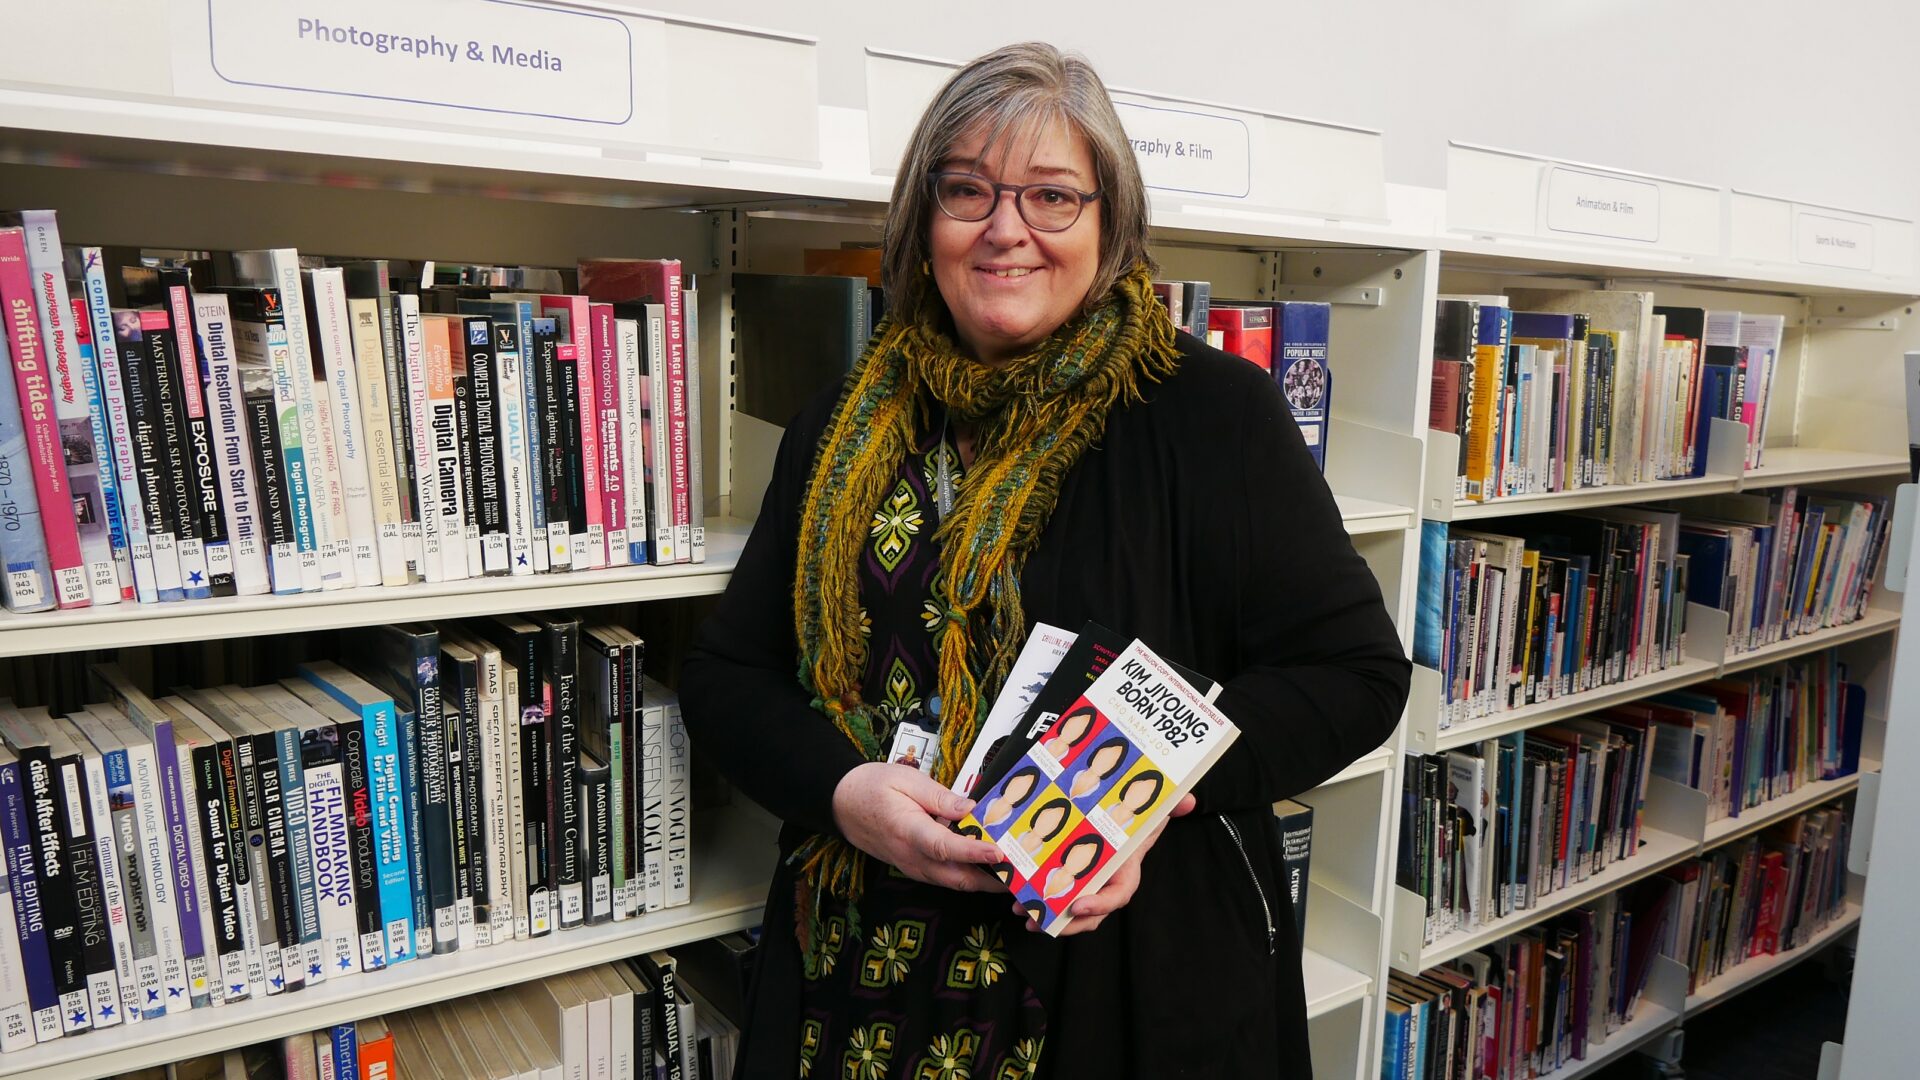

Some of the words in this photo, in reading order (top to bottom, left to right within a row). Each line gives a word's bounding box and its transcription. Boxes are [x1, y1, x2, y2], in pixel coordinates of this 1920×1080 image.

[298, 18, 458, 63] Photography
[466, 41, 484, 62] &
[492, 44, 562, 72] Media
[1175, 140, 1185, 157] &
[1189, 143, 1213, 161] Film
[1576, 195, 1611, 213] Animation
[1613, 201, 1618, 213] &
[1620, 202, 1634, 215] Film
[37, 226, 48, 253] GREEN
[92, 279, 110, 342] complete
[199, 305, 226, 317] CTEIN
[670, 275, 680, 316] MEDIUM
[43, 272, 60, 328] American
[55, 329, 74, 404] Photography
[208, 322, 225, 362] Digital
[406, 309, 419, 337] The
[601, 314, 610, 347] Advanced
[671, 320, 679, 340] AND
[12, 299, 38, 370] shifting
[26, 374, 47, 421] tides
[102, 348, 121, 391] digital
[284, 268, 298, 313] DIGITAL
[303, 402, 316, 445] BEYOND
[408, 342, 423, 382] Digital
[542, 341, 554, 382] Exposure
[671, 344, 682, 375] LARGE
[1286, 349, 1310, 357] POPULAR
[1312, 349, 1325, 357] MUSIC
[274, 350, 294, 402] Simplified
[473, 353, 490, 399] COMPLETE
[523, 320, 532, 346] Digital
[529, 411, 537, 443] Creative
[602, 349, 612, 406] Photoshop
[1736, 373, 1746, 403] GAME
[126, 351, 146, 417] alternative
[136, 421, 157, 465] digital
[152, 334, 172, 405] MASTERING
[162, 402, 177, 446] DIGITAL
[170, 447, 182, 467] SLR
[214, 365, 236, 433] Restoration
[108, 395, 134, 481] photography
[257, 404, 268, 448] DIGITAL
[263, 449, 277, 483] BLACK
[342, 402, 355, 460] Photography
[412, 389, 432, 471] Photography
[432, 404, 456, 452] Digital
[545, 401, 558, 445] Lighting
[607, 408, 619, 472] Elements
[89, 401, 114, 493] PHOTOGRAPHY
[104, 492, 120, 522] MADE
[192, 421, 216, 513] EXPOSURE
[225, 435, 240, 466] From
[375, 429, 391, 477] essential
[462, 441, 470, 466] PHOTO
[479, 436, 496, 500] PHOTOGRAPHY
[585, 445, 595, 492] Solutions
[675, 421, 686, 489] PHOTOGRAPHY
[230, 469, 248, 498] Start
[291, 461, 303, 495] Digital
[381, 480, 394, 507] skills
[438, 457, 458, 516] Camera
[465, 466, 475, 512] RETOUCHING
[512, 466, 520, 487] Digital
[421, 473, 437, 539] Workbook
[512, 488, 522, 536] Photography
[183, 548, 199, 556] BUS
[322, 551, 337, 559] FAR
[15, 588, 35, 596] HON
[65, 584, 83, 593] CUB
[68, 592, 85, 600] WRI
[95, 578, 113, 586] GRE
[488, 664, 498, 694] HAAS
[561, 674, 573, 711] Faces
[1135, 646, 1143, 656] THE
[1168, 675, 1200, 705] INTERNATIONAL
[1199, 702, 1225, 727] BESTSELLER
[424, 688, 436, 728] COLOUR
[1116, 680, 1160, 720] BORN
[1153, 713, 1188, 748] 1982
[1121, 658, 1152, 686] KIM
[1144, 682, 1209, 744] JIYOUNG,
[375, 710, 387, 747] Wright
[222, 749, 234, 778] Digital
[347, 730, 363, 789] Corporate
[385, 754, 397, 793] Digital
[427, 730, 442, 804] PHOTOGRAPHY
[511, 723, 519, 783] SPECIAL
[136, 758, 151, 799] MOVING
[204, 759, 212, 790] HOLMAN
[262, 770, 280, 804] DSLR
[309, 778, 340, 789] DIGITAL
[375, 776, 386, 803] Film
[563, 760, 577, 824] Twentieth
[30, 759, 49, 796] cheat
[42, 833, 60, 877] Effects
[142, 802, 156, 834] IMAGE
[208, 798, 224, 839] Sound
[227, 780, 240, 829] Filmmaking
[247, 799, 258, 827] VIDEO
[285, 787, 306, 826] VIDEO
[353, 787, 367, 827] Video
[513, 795, 522, 855] EFFECTS
[267, 808, 285, 858] CINEMA
[309, 789, 335, 900] HANDBOOK
[326, 786, 352, 907] FILMMAKING
[388, 795, 402, 862] Compositing
[669, 796, 685, 861] VOGUE
[18, 844, 31, 876] FILM
[71, 849, 91, 885] FILM
[149, 837, 167, 904] TECHNOLOGY
[294, 828, 311, 883] PRODUCTION
[357, 827, 373, 889] Production
[383, 869, 405, 879] Second
[564, 827, 577, 882] Century
[217, 864, 232, 902] Digital
[474, 867, 483, 892] FROST
[1291, 867, 1300, 904] ACTORS
[23, 881, 43, 932] EDITING
[77, 887, 100, 946] EDITING
[223, 908, 237, 940] Video
[301, 887, 317, 935] HANDBOOK
[64, 960, 73, 984] Perkins
[141, 979, 158, 987] DAW
[164, 973, 179, 981] ENT
[663, 972, 674, 1000] BJP
[641, 1007, 651, 1043] ROBIN
[664, 1003, 678, 1058] ANNUAL
[687, 1032, 695, 1051] THE
